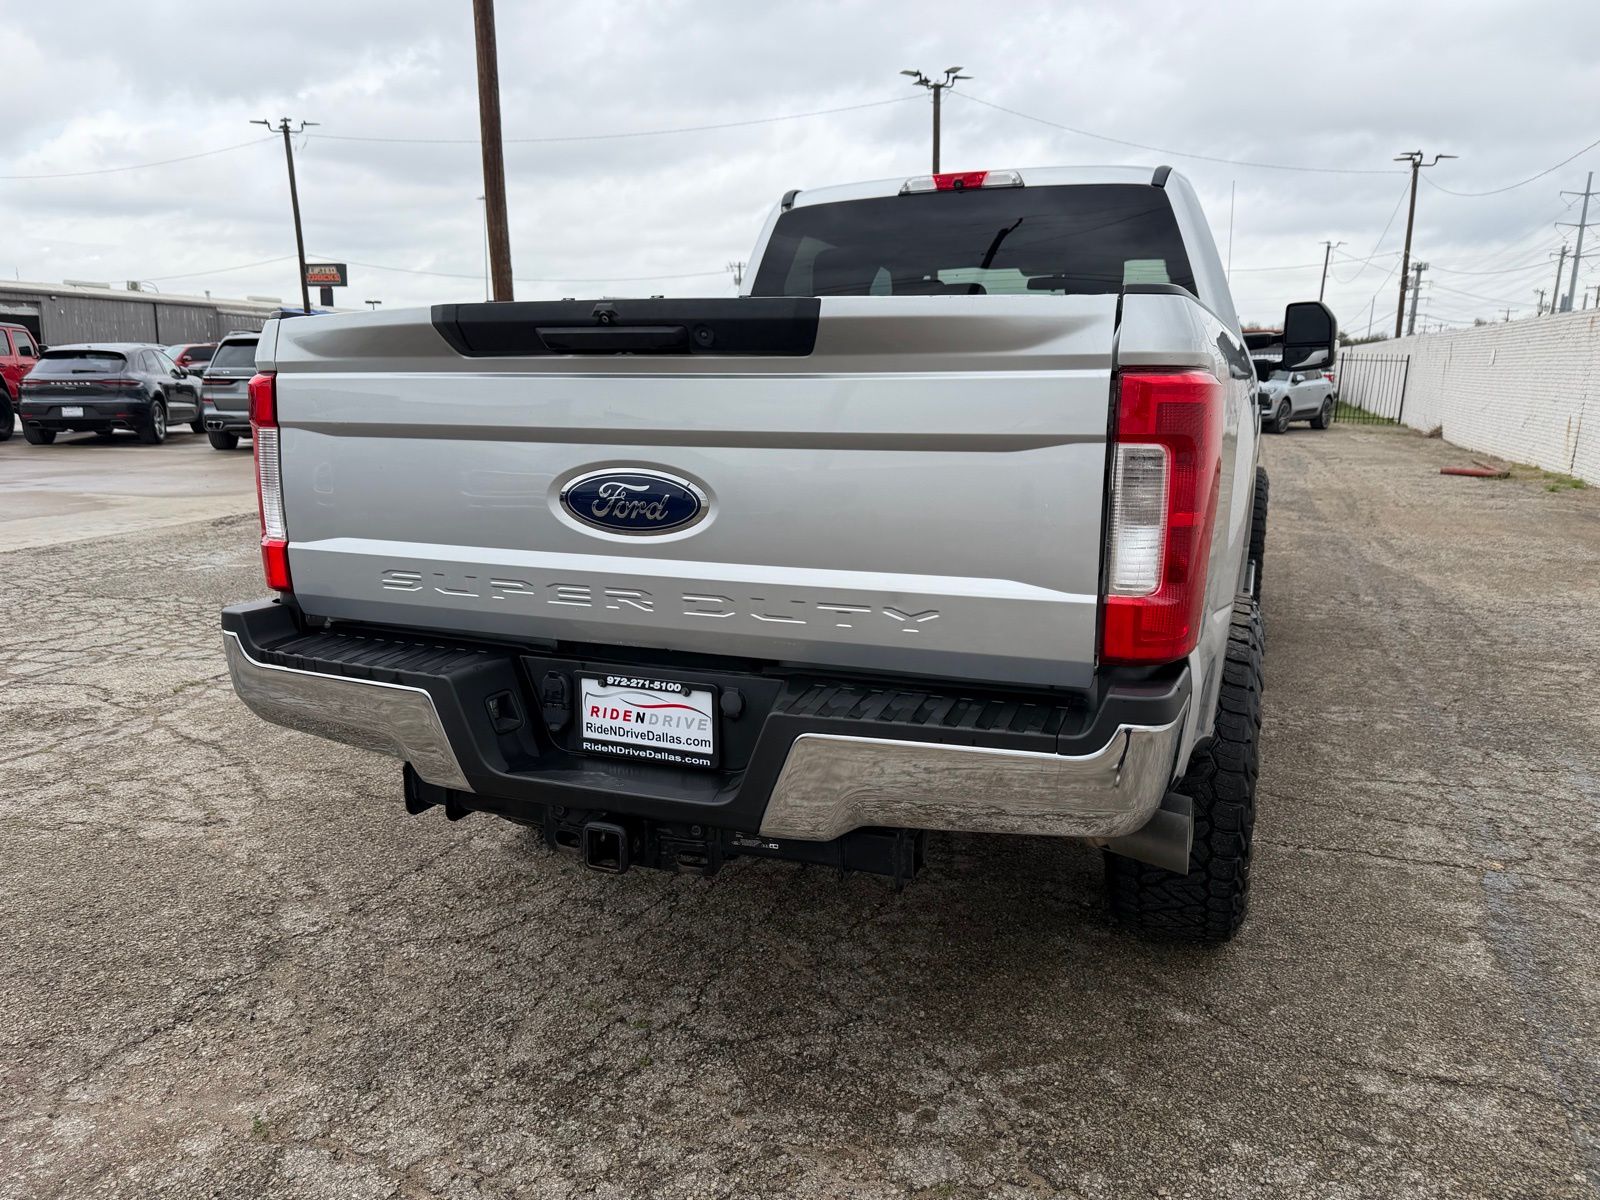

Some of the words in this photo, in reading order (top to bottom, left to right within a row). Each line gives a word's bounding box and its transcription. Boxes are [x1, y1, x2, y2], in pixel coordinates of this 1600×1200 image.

[592, 481, 671, 521] Ford
[381, 568, 654, 613] SUPER
[682, 592, 941, 634] DUTY
[606, 676, 682, 692] 972-271-5100
[586, 722, 711, 748] RideNDriveDallas.com
[583, 742, 711, 766] RideNDriveDallas.com
